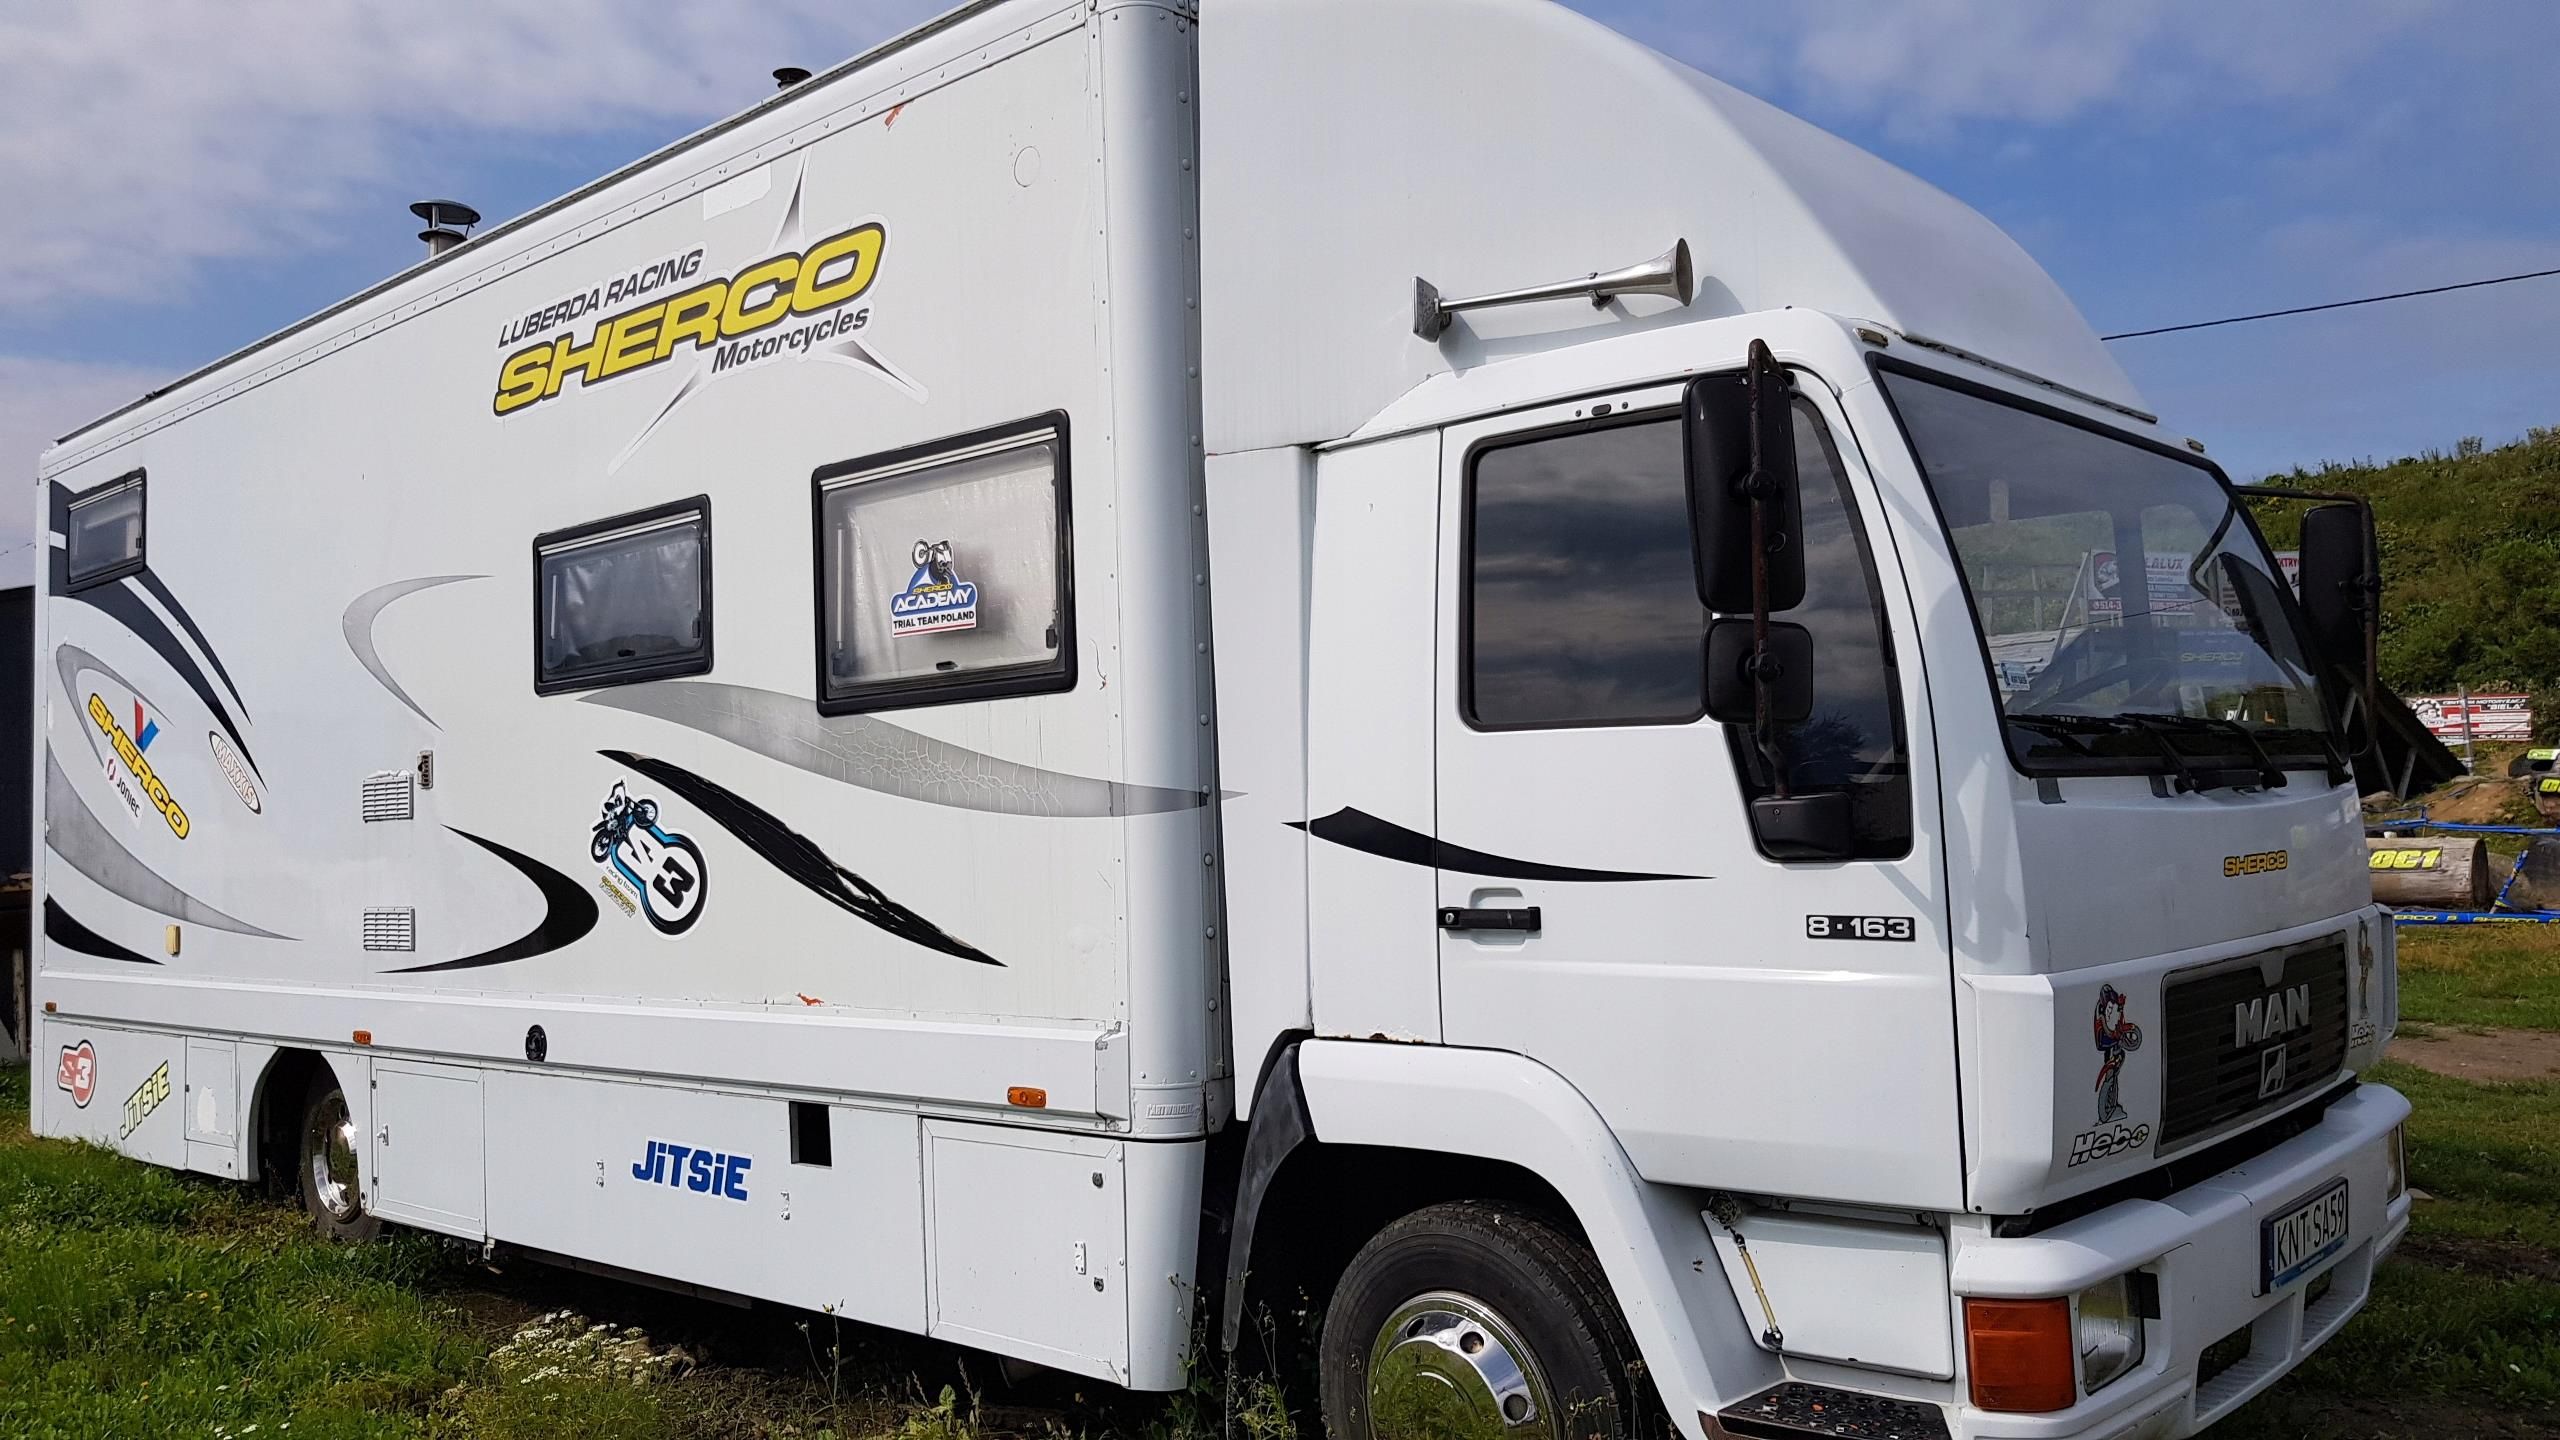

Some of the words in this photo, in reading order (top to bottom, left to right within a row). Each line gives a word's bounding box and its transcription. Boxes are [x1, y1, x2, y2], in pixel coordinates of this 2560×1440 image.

[494, 221, 886, 417] SHERCO
[498, 287, 599, 348] LUBERDA
[604, 248, 704, 303] RACING
[711, 307, 870, 374] Motorcycles
[893, 587, 973, 613] ACADEMY
[893, 617, 916, 630] TRIAL
[917, 615, 940, 626] TEAM
[941, 611, 975, 624] POLAND
[88, 692, 190, 840] SHERCO
[214, 737, 256, 806] MAXXIS
[652, 855, 696, 909] 3
[2224, 849, 2288, 877] SHERCO
[2235, 983, 2310, 1049] MAN
[2068, 1123, 2150, 1168] Hebo
[2277, 1209, 2309, 1272] KNT
[2312, 1189, 2345, 1248] SA59
